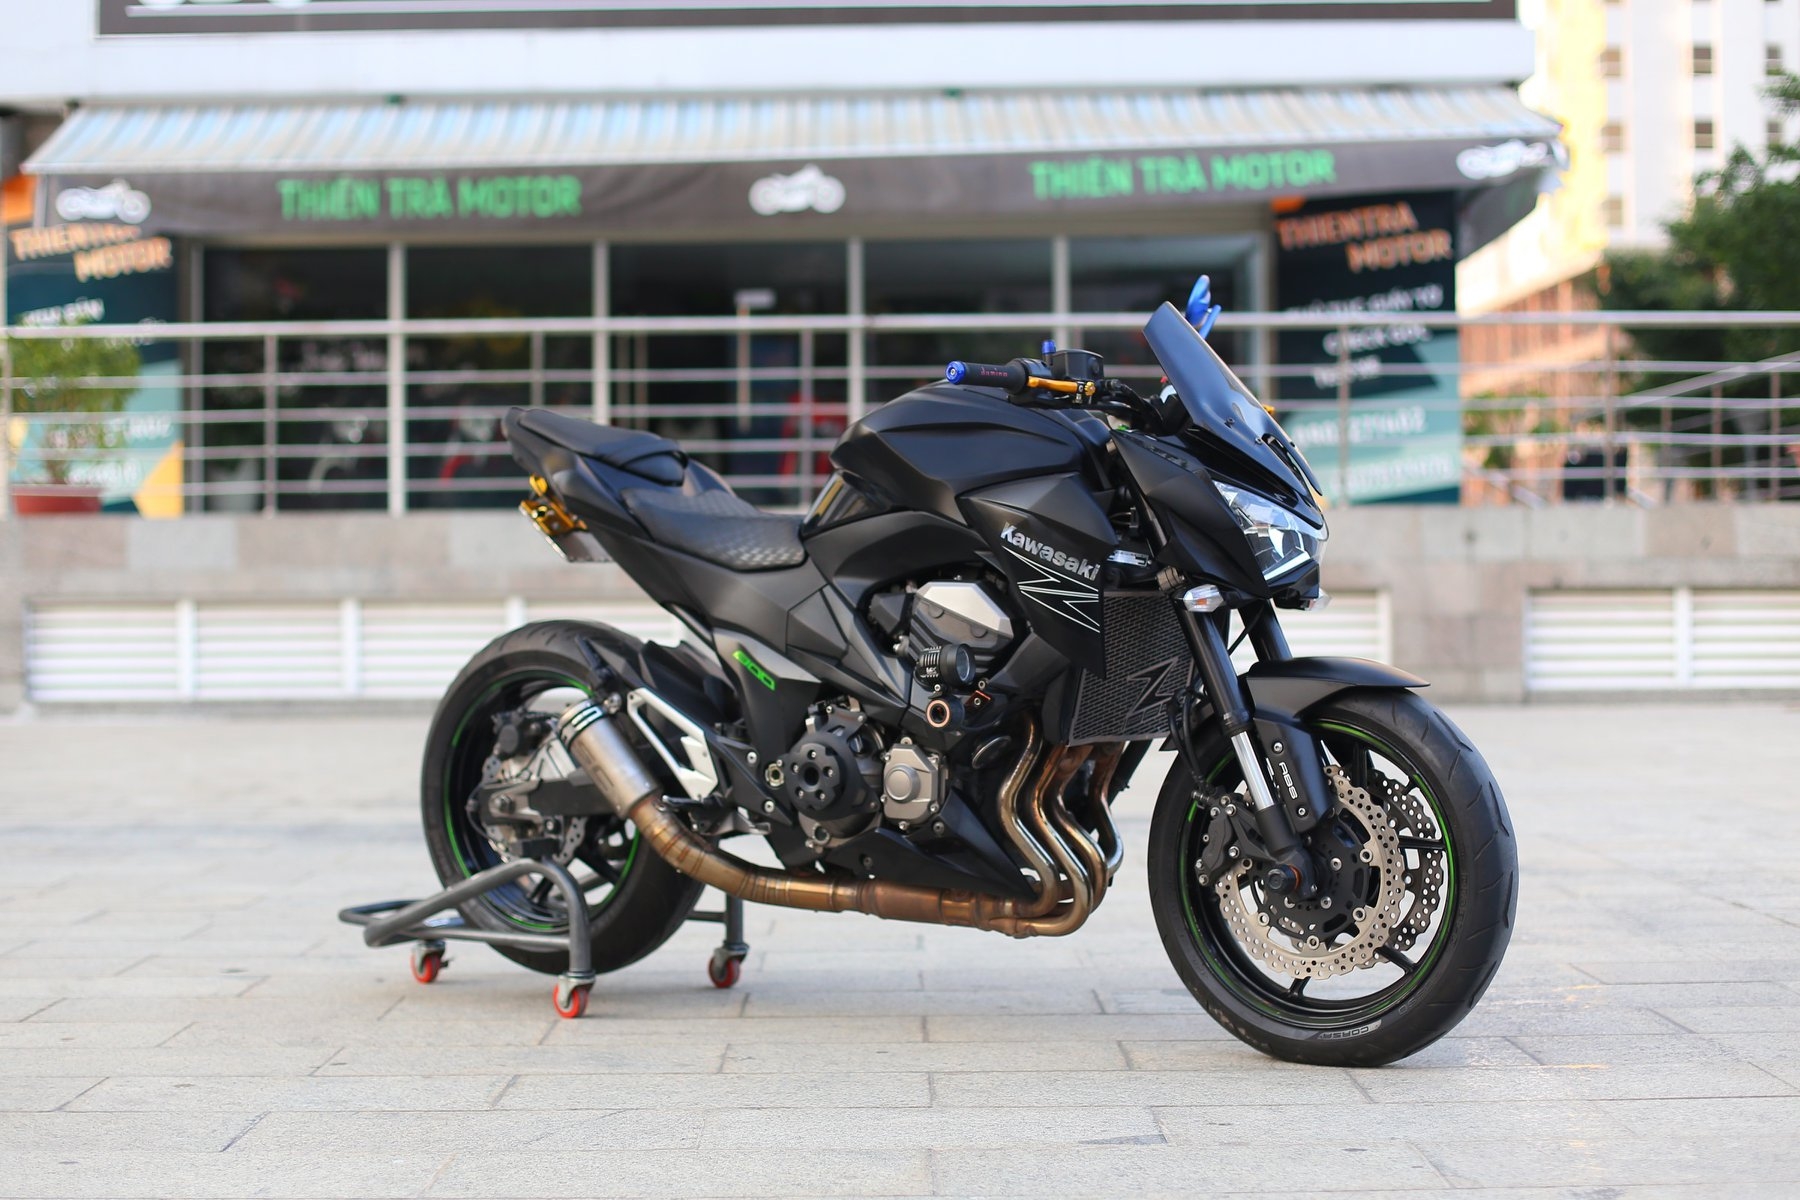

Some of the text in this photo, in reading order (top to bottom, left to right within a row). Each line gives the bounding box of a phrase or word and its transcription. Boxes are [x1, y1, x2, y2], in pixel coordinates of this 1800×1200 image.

[1209, 149, 1337, 192] MOTOR
[456, 174, 584, 218] MOTOR
[73, 236, 174, 283] MOTOR
[1346, 229, 1453, 274] MOTOR
[1000, 521, 1101, 581] Kawasaki
[1278, 761, 1299, 800] ABS
